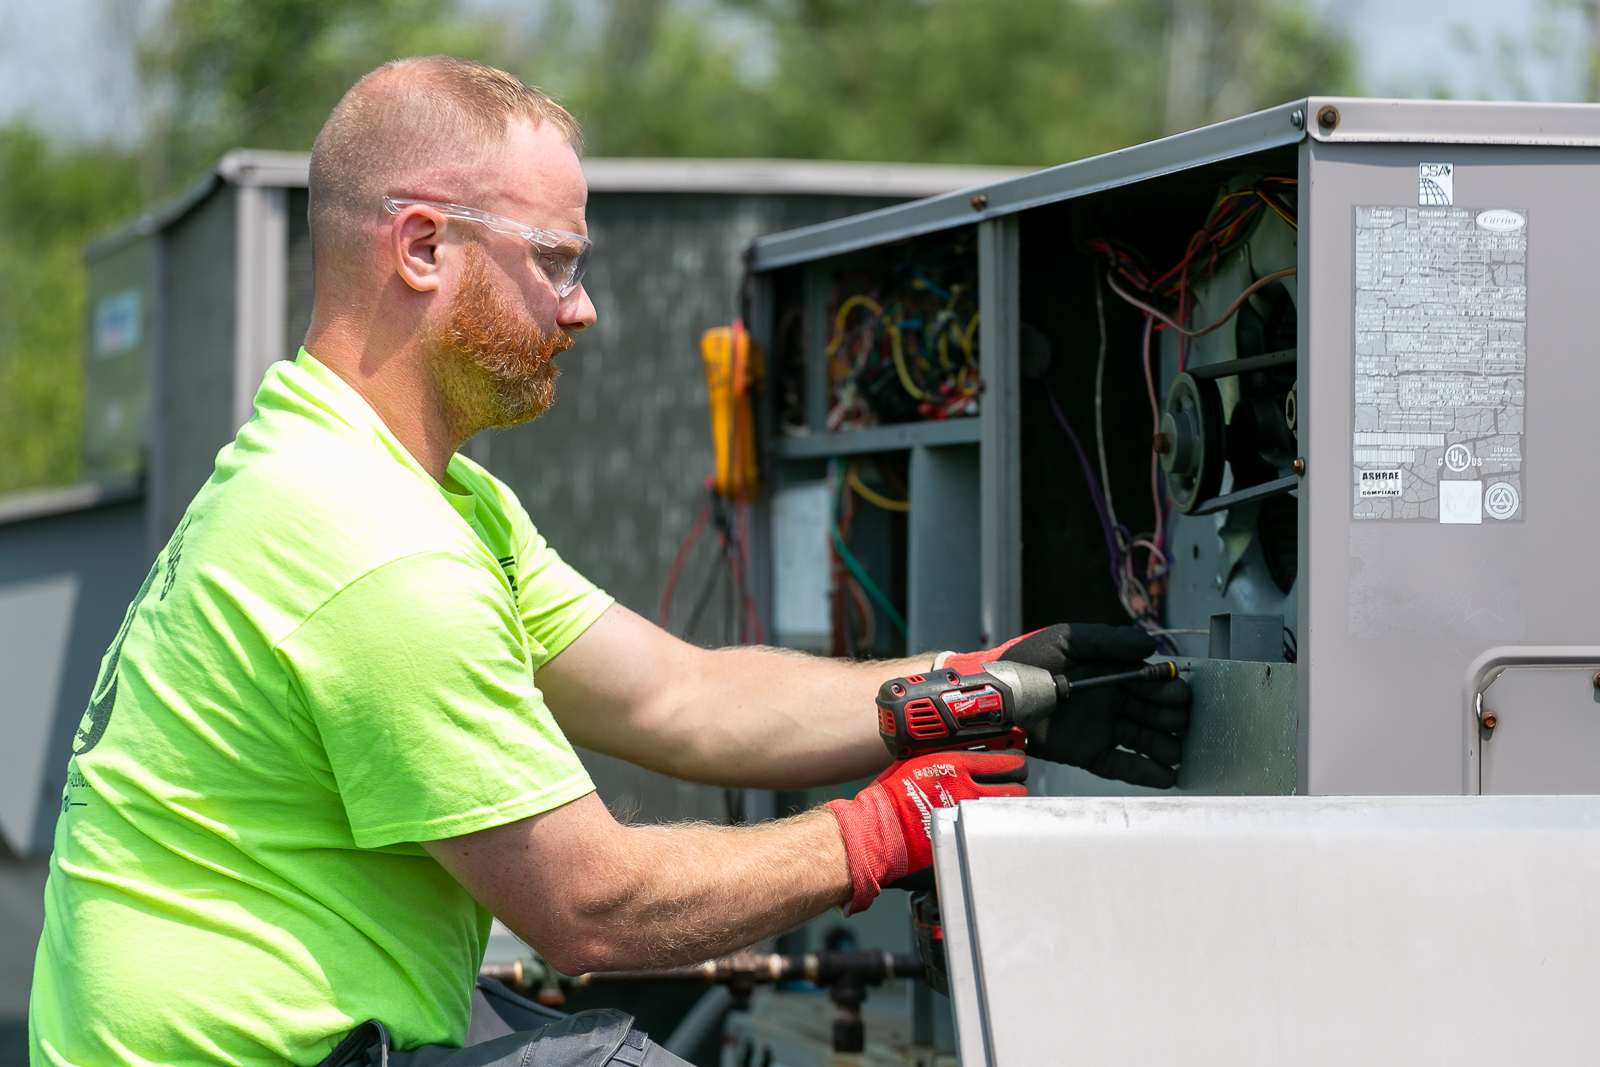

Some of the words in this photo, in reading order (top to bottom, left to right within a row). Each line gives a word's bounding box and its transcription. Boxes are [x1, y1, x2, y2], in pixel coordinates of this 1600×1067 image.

[1420, 165, 1448, 177] CSA
[1371, 209, 1393, 218] Carrier
[1483, 215, 1519, 225] Carrier
[1450, 449, 1465, 467] UL
[1471, 457, 1483, 467] US
[1362, 471, 1400, 480] ASHRAE
[1363, 480, 1398, 490] 90.1
